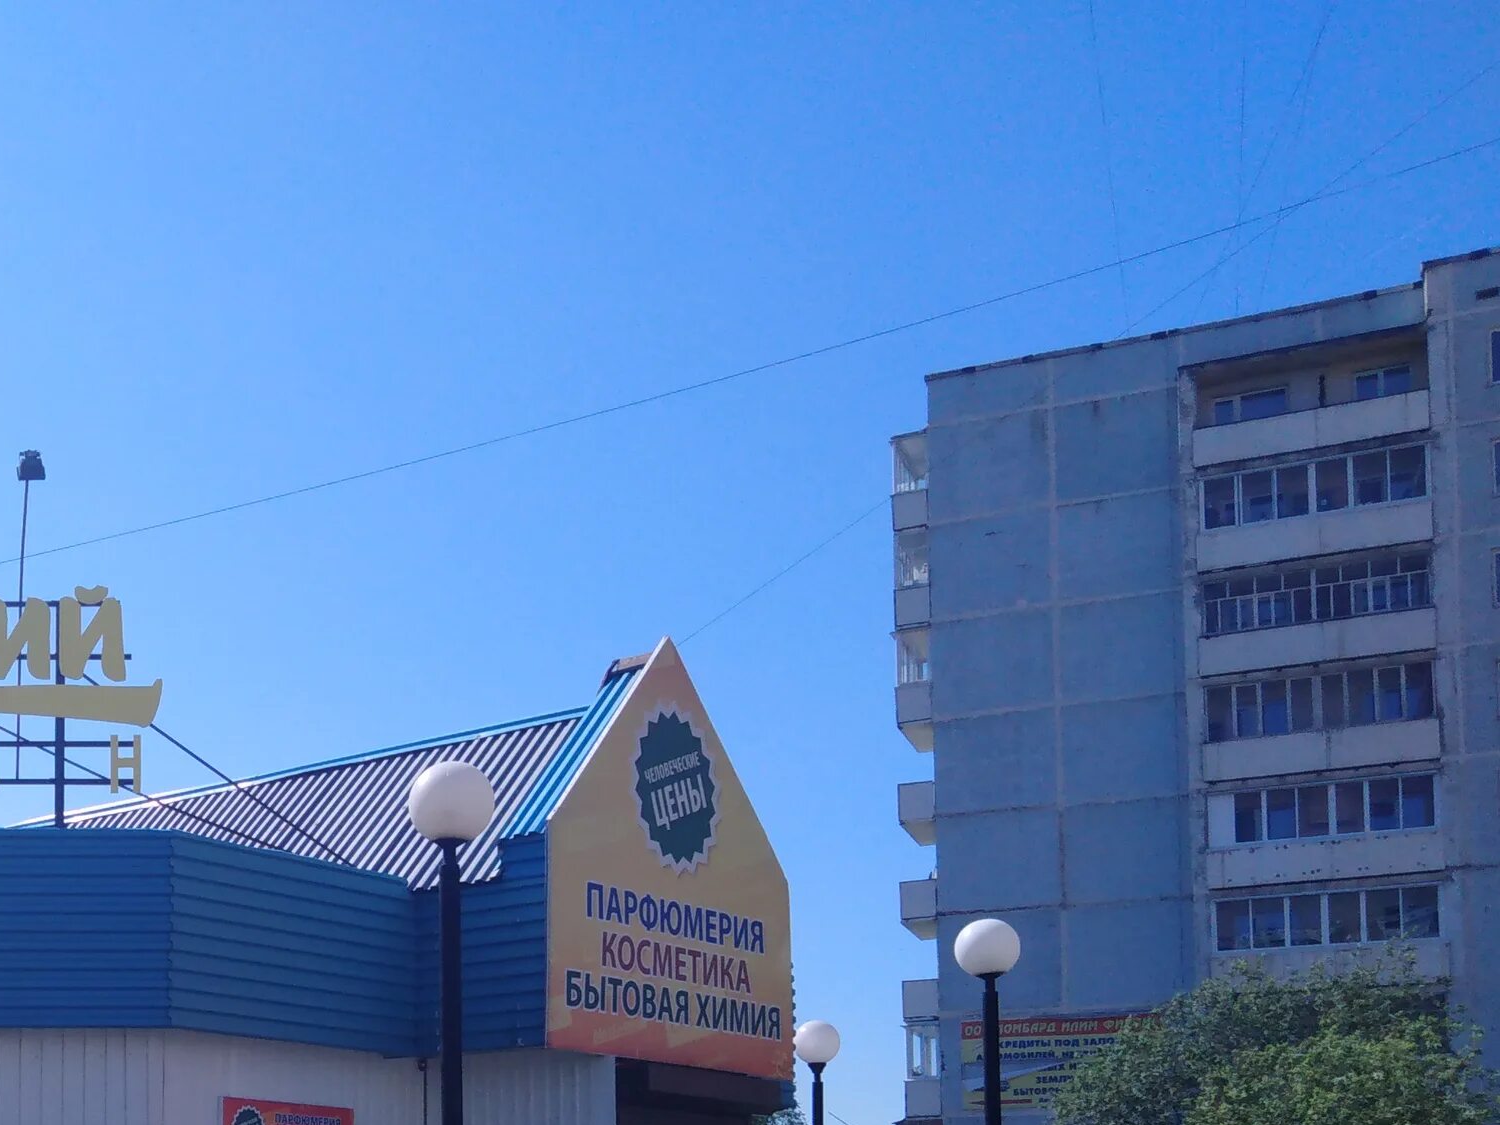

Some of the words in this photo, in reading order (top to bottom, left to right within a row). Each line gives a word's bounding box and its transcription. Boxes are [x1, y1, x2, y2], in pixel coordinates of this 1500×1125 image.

[644, 751, 700, 784] ЧЕЛОВЕЧЕСКИЕ
[650, 774, 708, 830] ЦЕНЫ
[586, 882, 765, 954] ПАРФЮМЕРИЯ
[602, 931, 751, 994] КОСМЕТИКА
[566, 970, 689, 1025] БЫТОВАЯ
[696, 991, 782, 1041] ХИМИЯ
[1055, 1038, 1080, 1047] ПОД
[1083, 1037, 1119, 1046] ЗАЛО
